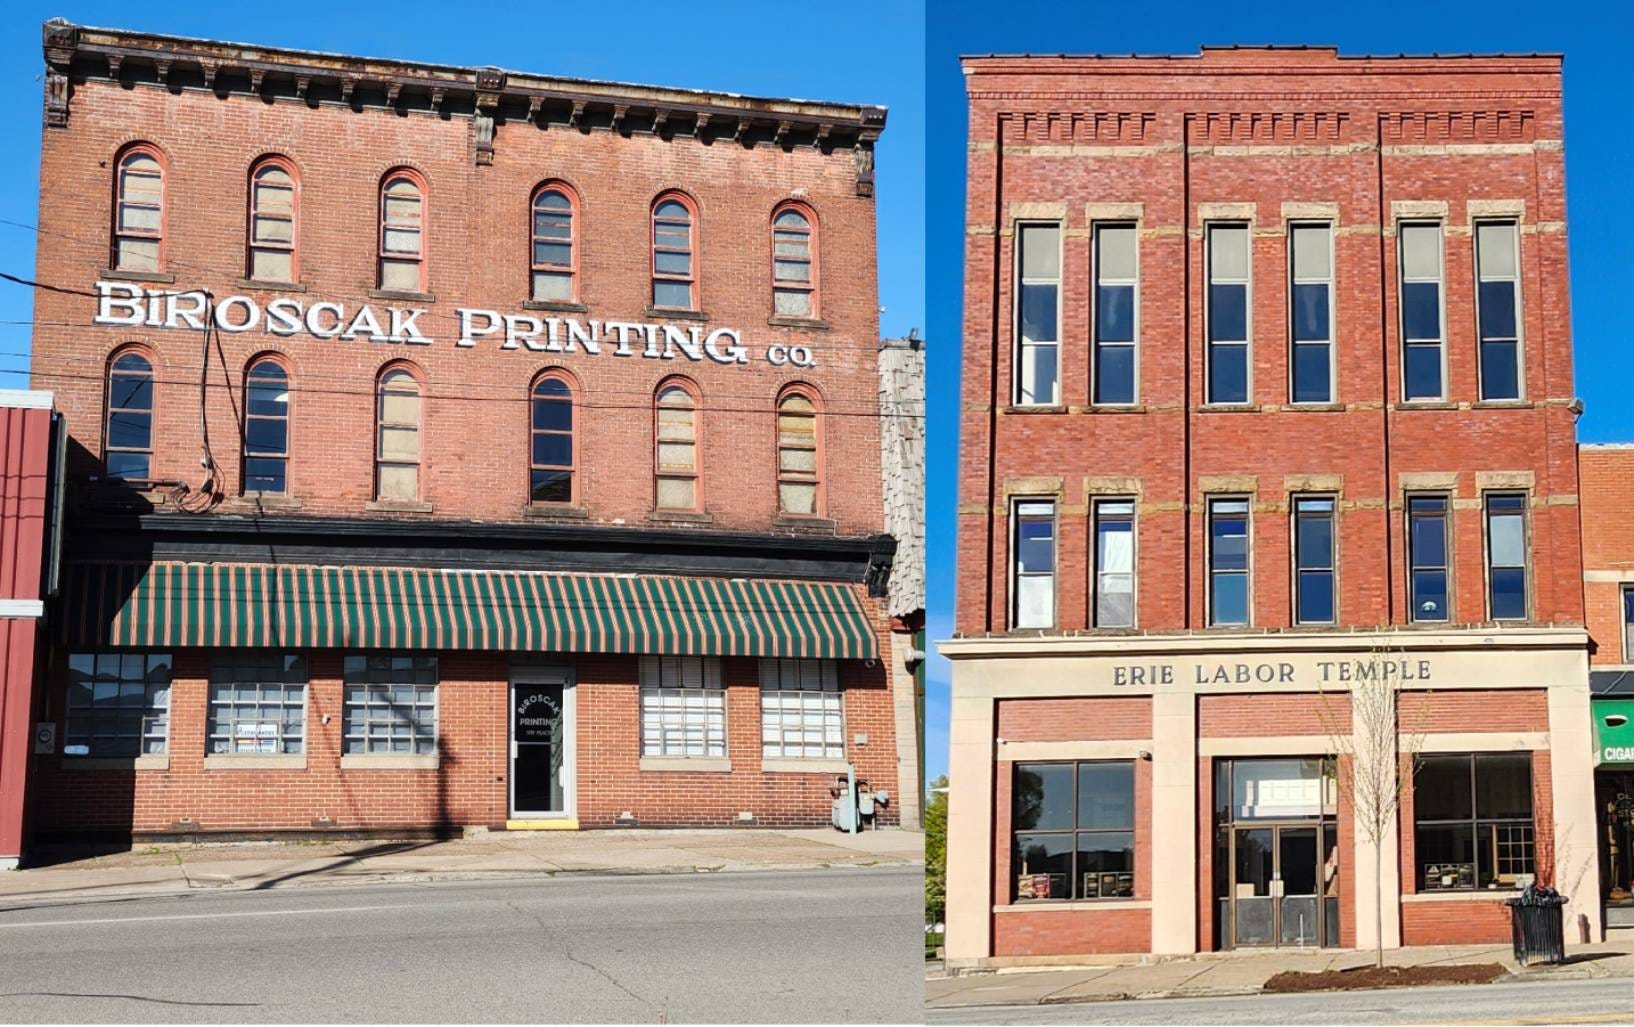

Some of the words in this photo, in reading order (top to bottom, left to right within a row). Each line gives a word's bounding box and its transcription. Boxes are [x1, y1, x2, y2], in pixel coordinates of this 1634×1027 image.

[455, 307, 750, 365] PRINTING
[766, 344, 817, 368] CO.
[1113, 665, 1175, 686] ERIE
[1195, 662, 1296, 684] LABOR
[1317, 660, 1432, 682] TEMPLE
[517, 694, 560, 714] BIROSCAK
